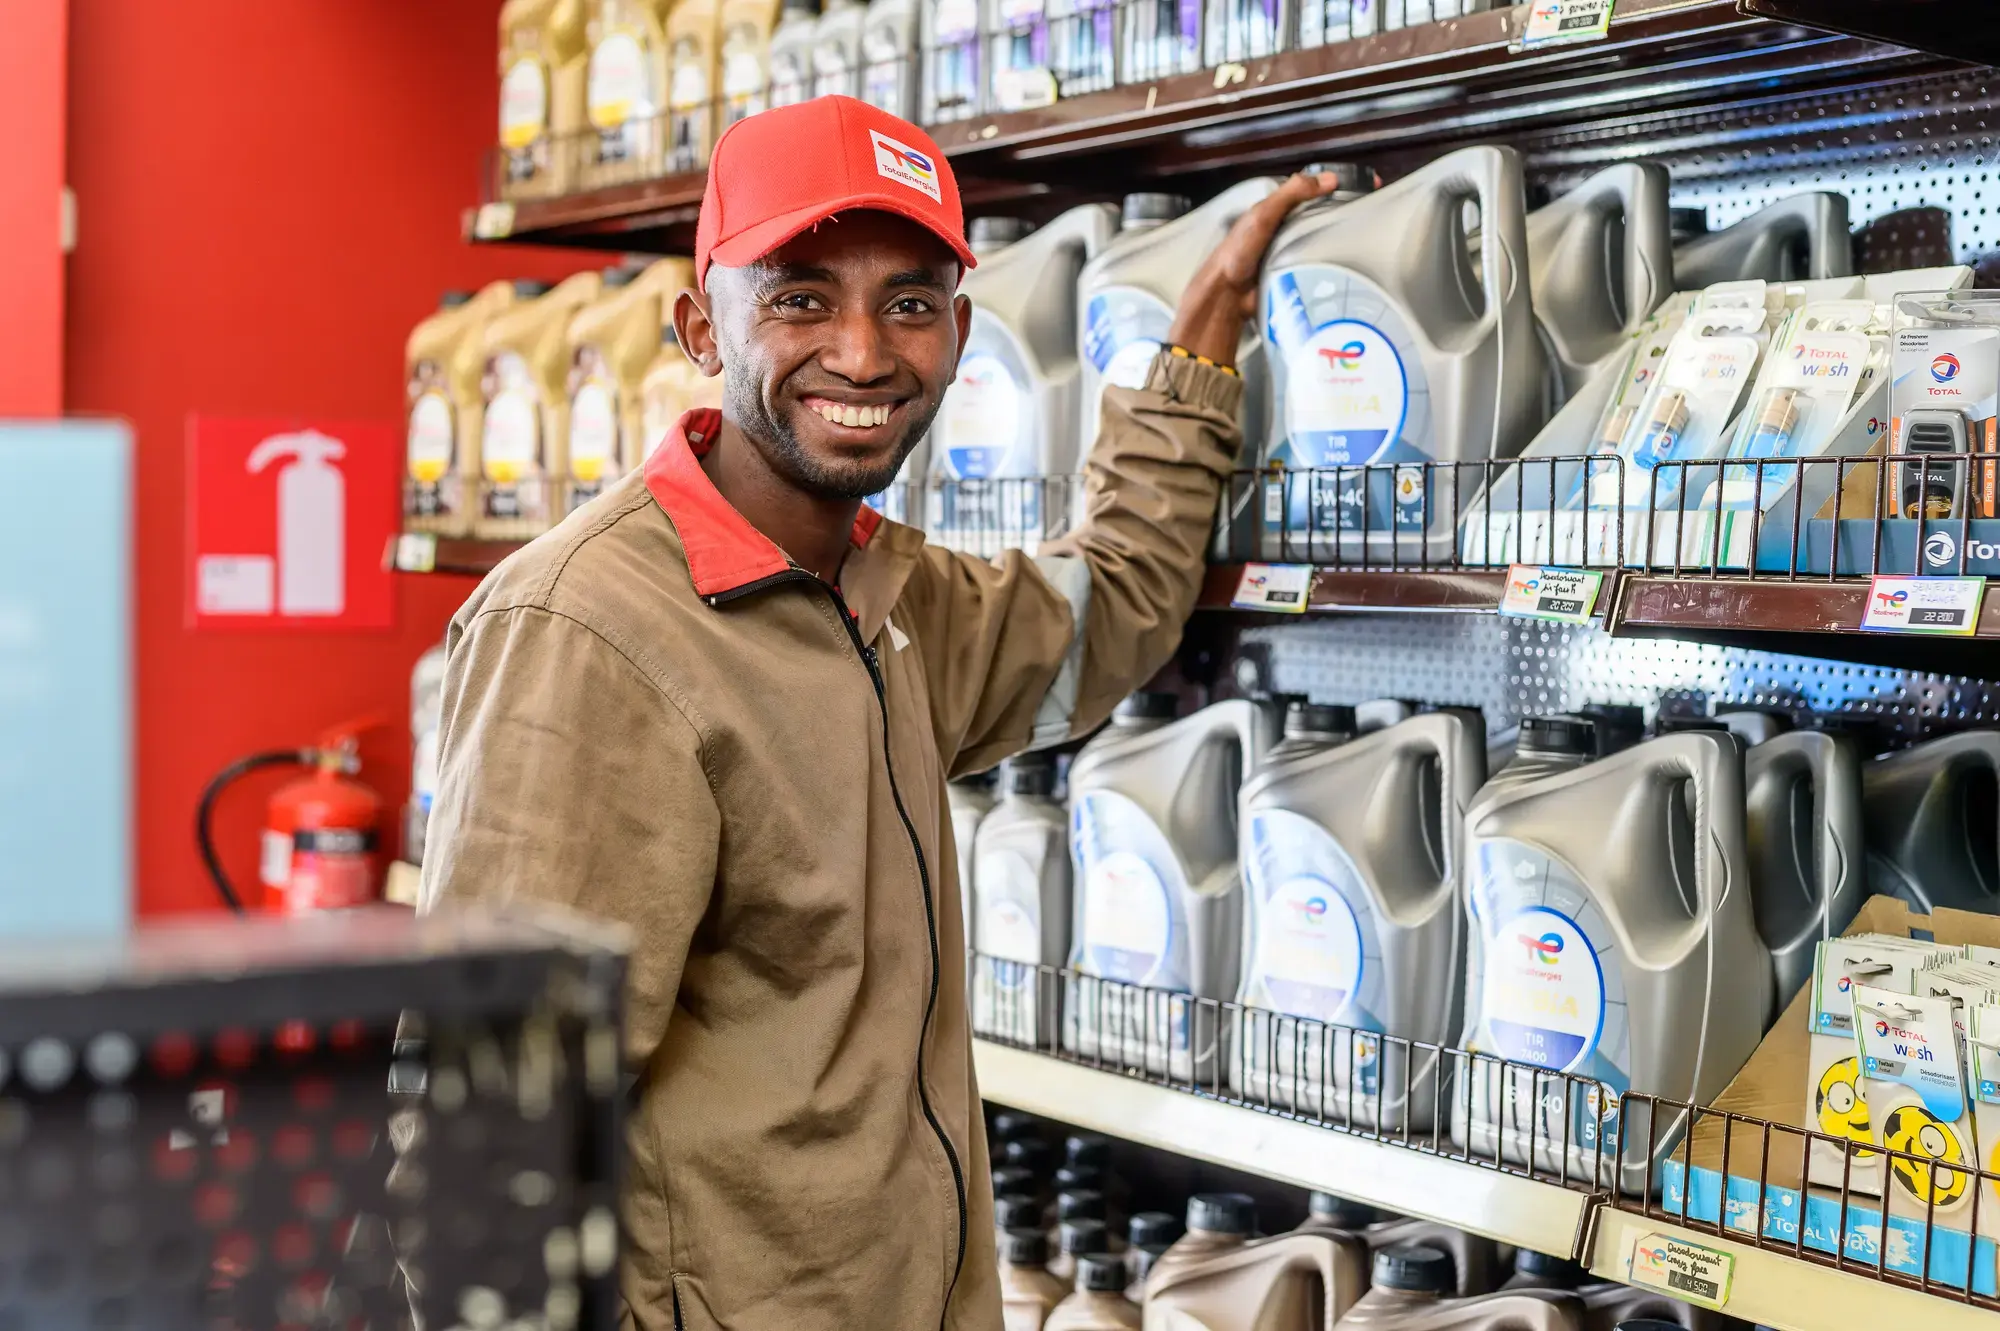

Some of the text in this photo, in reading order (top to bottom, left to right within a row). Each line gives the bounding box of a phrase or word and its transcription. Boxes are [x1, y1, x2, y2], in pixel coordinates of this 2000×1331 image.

[882, 164, 938, 195] TotalEnergies
[1809, 349, 1848, 359] TOTAL
[1802, 362, 1849, 377] wash
[1927, 387, 1962, 396] TOTAL
[1913, 472, 1946, 482] TTAL
[1986, 469, 1993, 479] de
[1985, 481, 1993, 503] Fruits
[1923, 611, 1955, 622] 22 200
[1524, 1032, 1544, 1048] TIR
[1891, 1027, 1928, 1043] TOTAL
[1894, 1043, 1934, 1062] wash
[1773, 1216, 1877, 1255] TOAL Was
